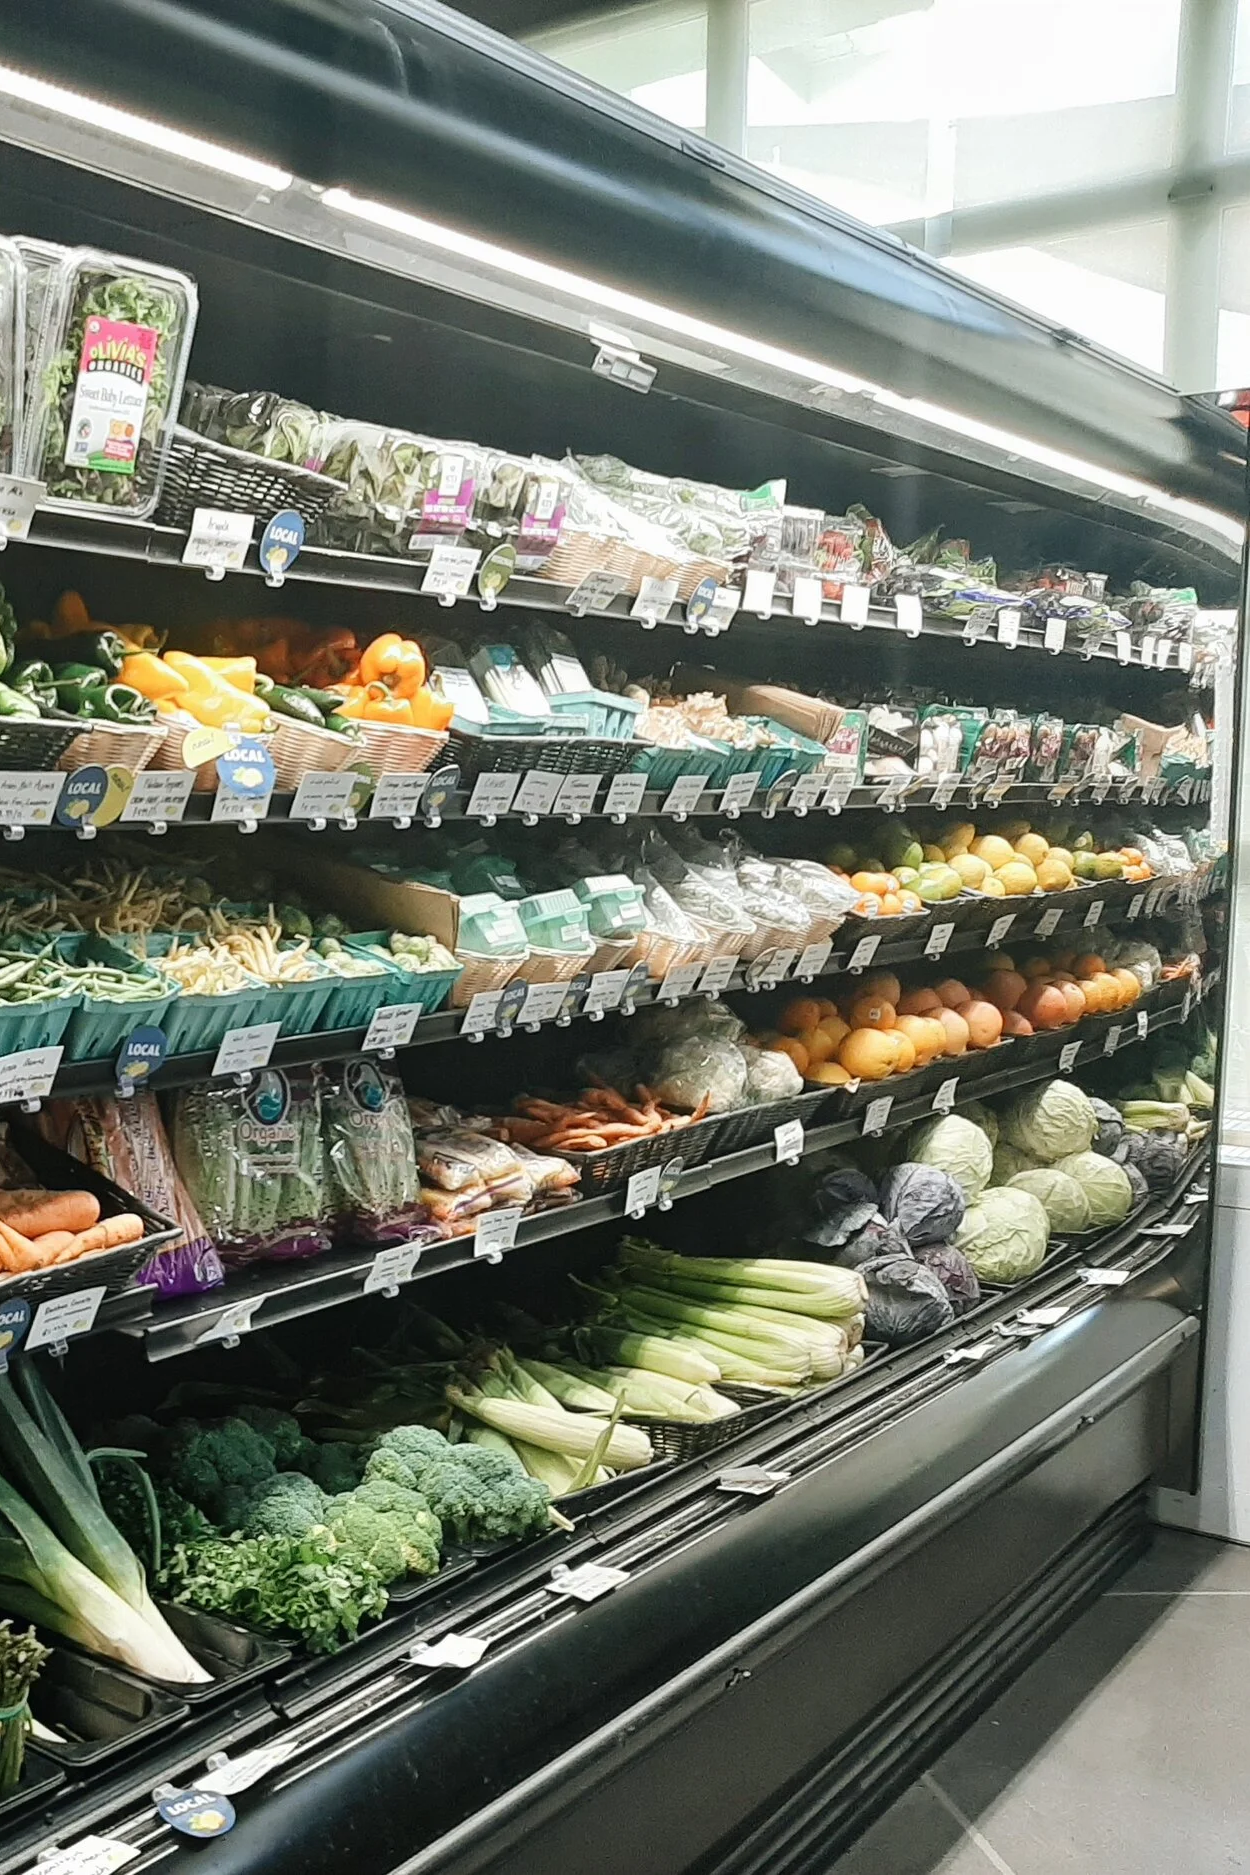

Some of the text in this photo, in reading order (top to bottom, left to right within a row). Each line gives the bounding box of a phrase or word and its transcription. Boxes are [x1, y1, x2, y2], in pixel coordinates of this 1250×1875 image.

[79, 384, 143, 407] Sweet Baby Lettuce
[269, 525, 299, 544] LOCAL
[223, 748, 266, 763] LOCAL
[67, 782, 103, 795] LOCAL
[127, 1043, 161, 1057] LOCAL
[239, 1122, 297, 1145] Organic
[166, 1793, 217, 1816] LOCAL
